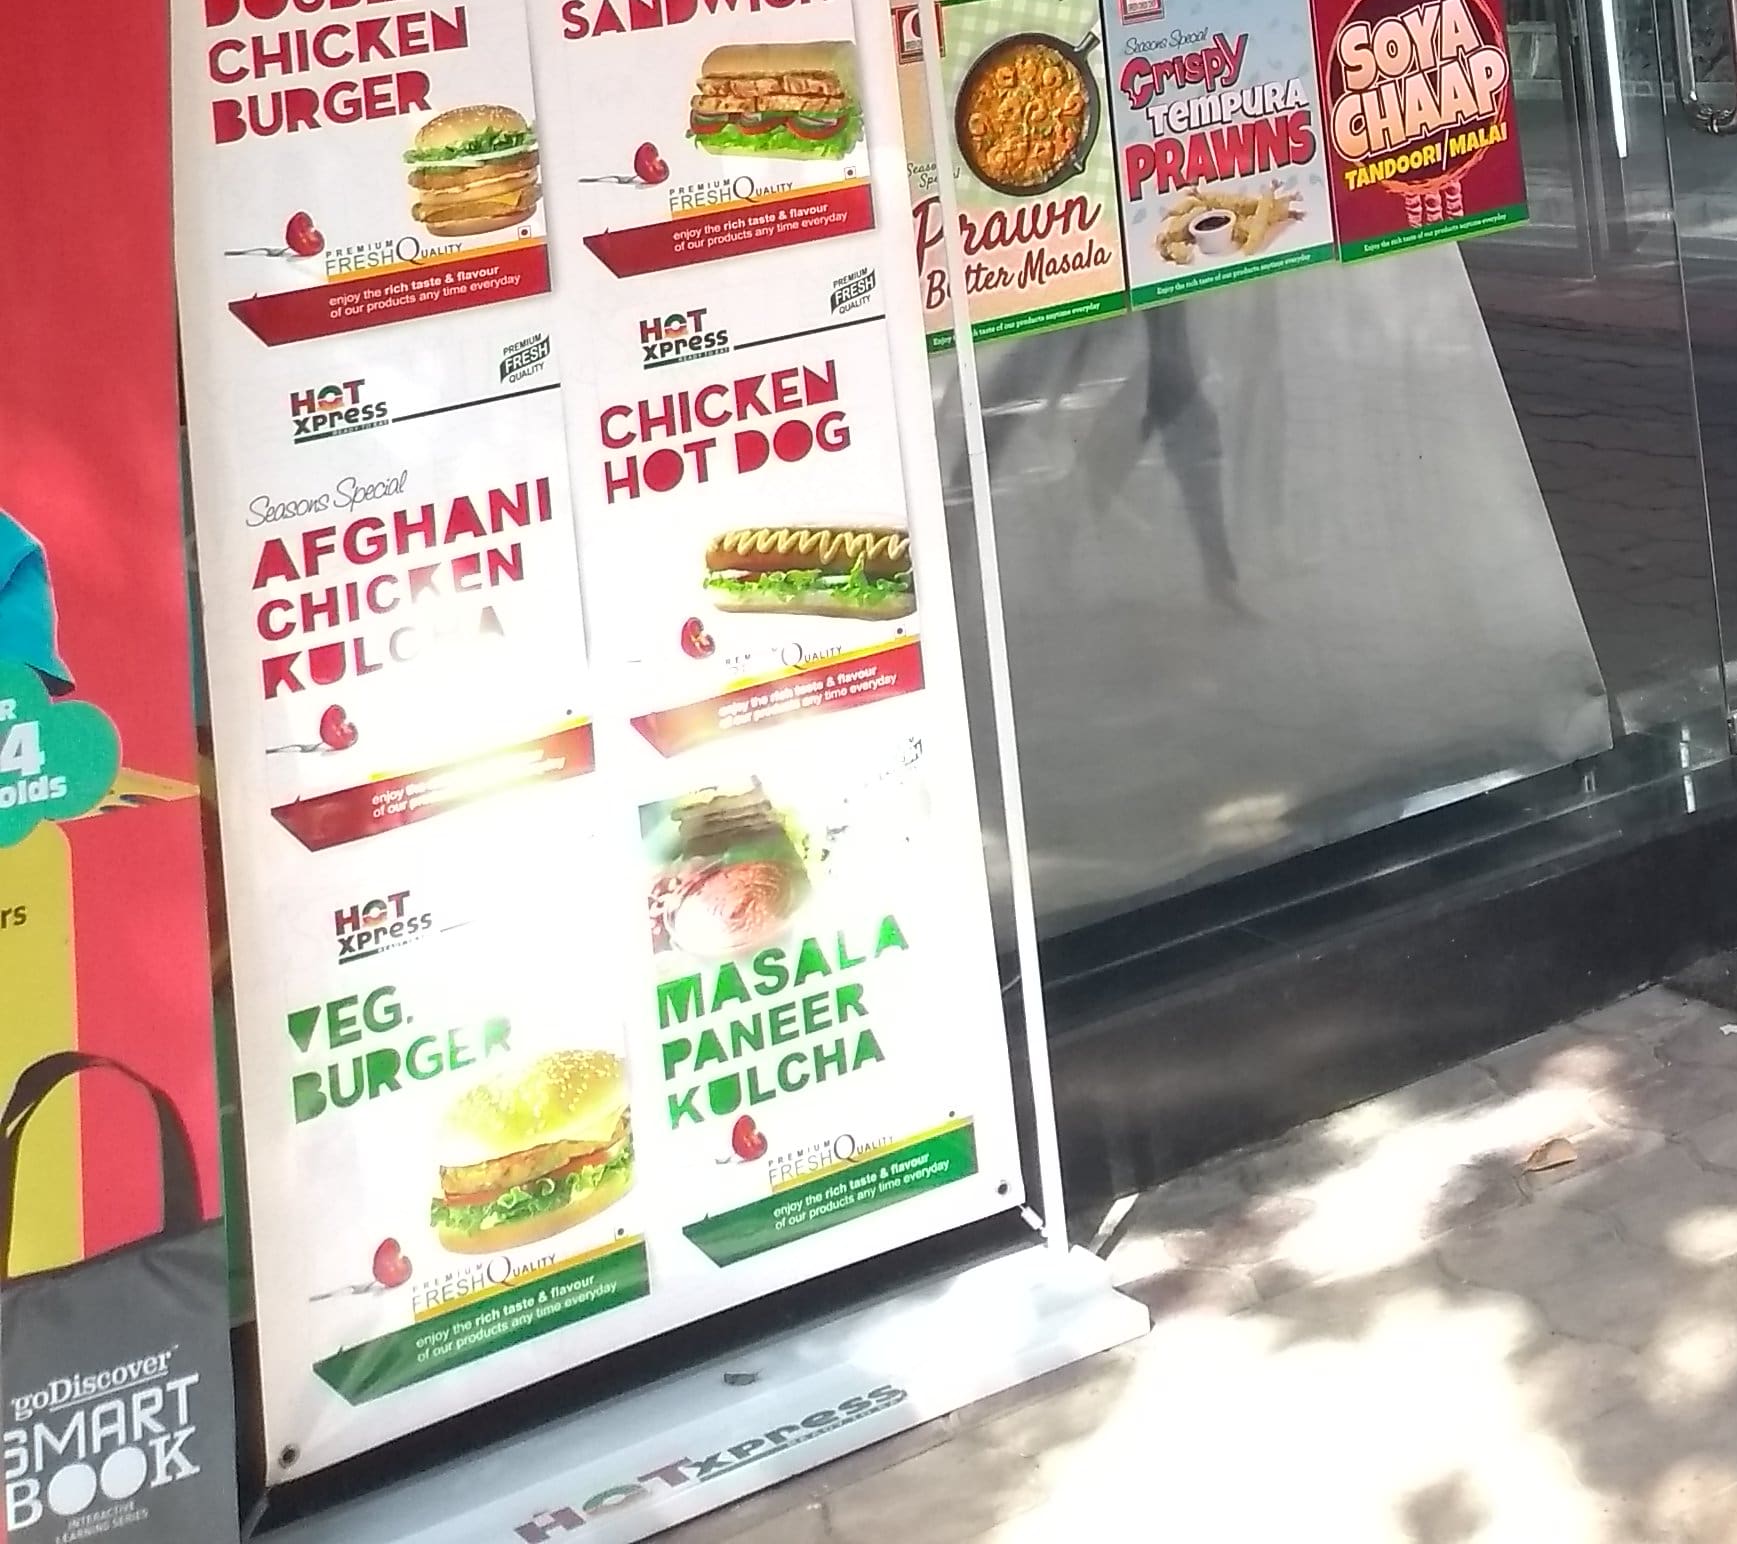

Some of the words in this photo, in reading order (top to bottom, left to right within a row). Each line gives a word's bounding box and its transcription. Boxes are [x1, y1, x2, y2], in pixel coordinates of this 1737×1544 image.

[209, 6, 469, 84] CHICKEN
[1120, 33, 1249, 109] Crispy
[212, 70, 432, 144] BURGER
[1332, 45, 1509, 162] CHAAP
[669, 178, 731, 196] PREMIUM
[1125, 111, 1316, 202] PRAWNS
[669, 187, 732, 212] FRESH
[732, 175, 793, 203] QUALITY
[672, 227, 702, 242] enjoy
[704, 223, 721, 236] the
[723, 218, 746, 231] rich
[748, 212, 776, 227] taste
[778, 209, 787, 220] &
[789, 203, 829, 219] flavour
[325, 248, 394, 276] FRESH
[396, 236, 462, 265] QUALITY
[326, 239, 393, 258] PREMIUM
[674, 239, 685, 252] of
[687, 237, 705, 250] our
[707, 229, 753, 248] products
[754, 225, 775, 239] any
[776, 220, 799, 233] time
[801, 211, 848, 230] everyday
[912, 195, 1101, 276] Prawn
[1018, 239, 1112, 289] Masala
[329, 291, 361, 308] enjoy
[363, 287, 382, 300] the
[384, 281, 409, 296] rich
[412, 276, 441, 291] taste
[445, 273, 454, 283] &
[457, 266, 500, 282] flavour
[330, 307, 342, 319] of
[345, 305, 365, 317] our
[367, 293, 417, 314] products
[419, 288, 441, 303] any
[443, 283, 467, 297] time
[470, 273, 521, 293] everyday
[835, 273, 874, 307] FRESH
[504, 344, 549, 376] FRESH
[640, 308, 707, 344] HOT
[290, 378, 365, 417] HOT
[600, 360, 839, 450] CHICKEN
[604, 438, 716, 504] HOT
[735, 411, 851, 474] DOG
[245, 494, 329, 527] Seasons
[334, 470, 408, 509] Special
[252, 477, 553, 590] AFGHANI
[256, 543, 525, 643] CHICKEN
[262, 606, 505, 700] KULCA
[334, 890, 410, 936] HOT
[657, 914, 910, 1031] MASALA
[287, 985, 414, 1054] VEG.
[662, 982, 869, 1082] PANEER
[292, 1017, 512, 1124] BURGER
[668, 1027, 885, 1131] KULCHA
[412, 1273, 485, 1312] FRESH
[487, 1254, 556, 1287] QUALITY
[13, 1350, 173, 1421] goDiscover
[3, 1372, 200, 1480] SMART
[6, 1425, 201, 1532] BOOK
[514, 1456, 692, 1544] HOT
